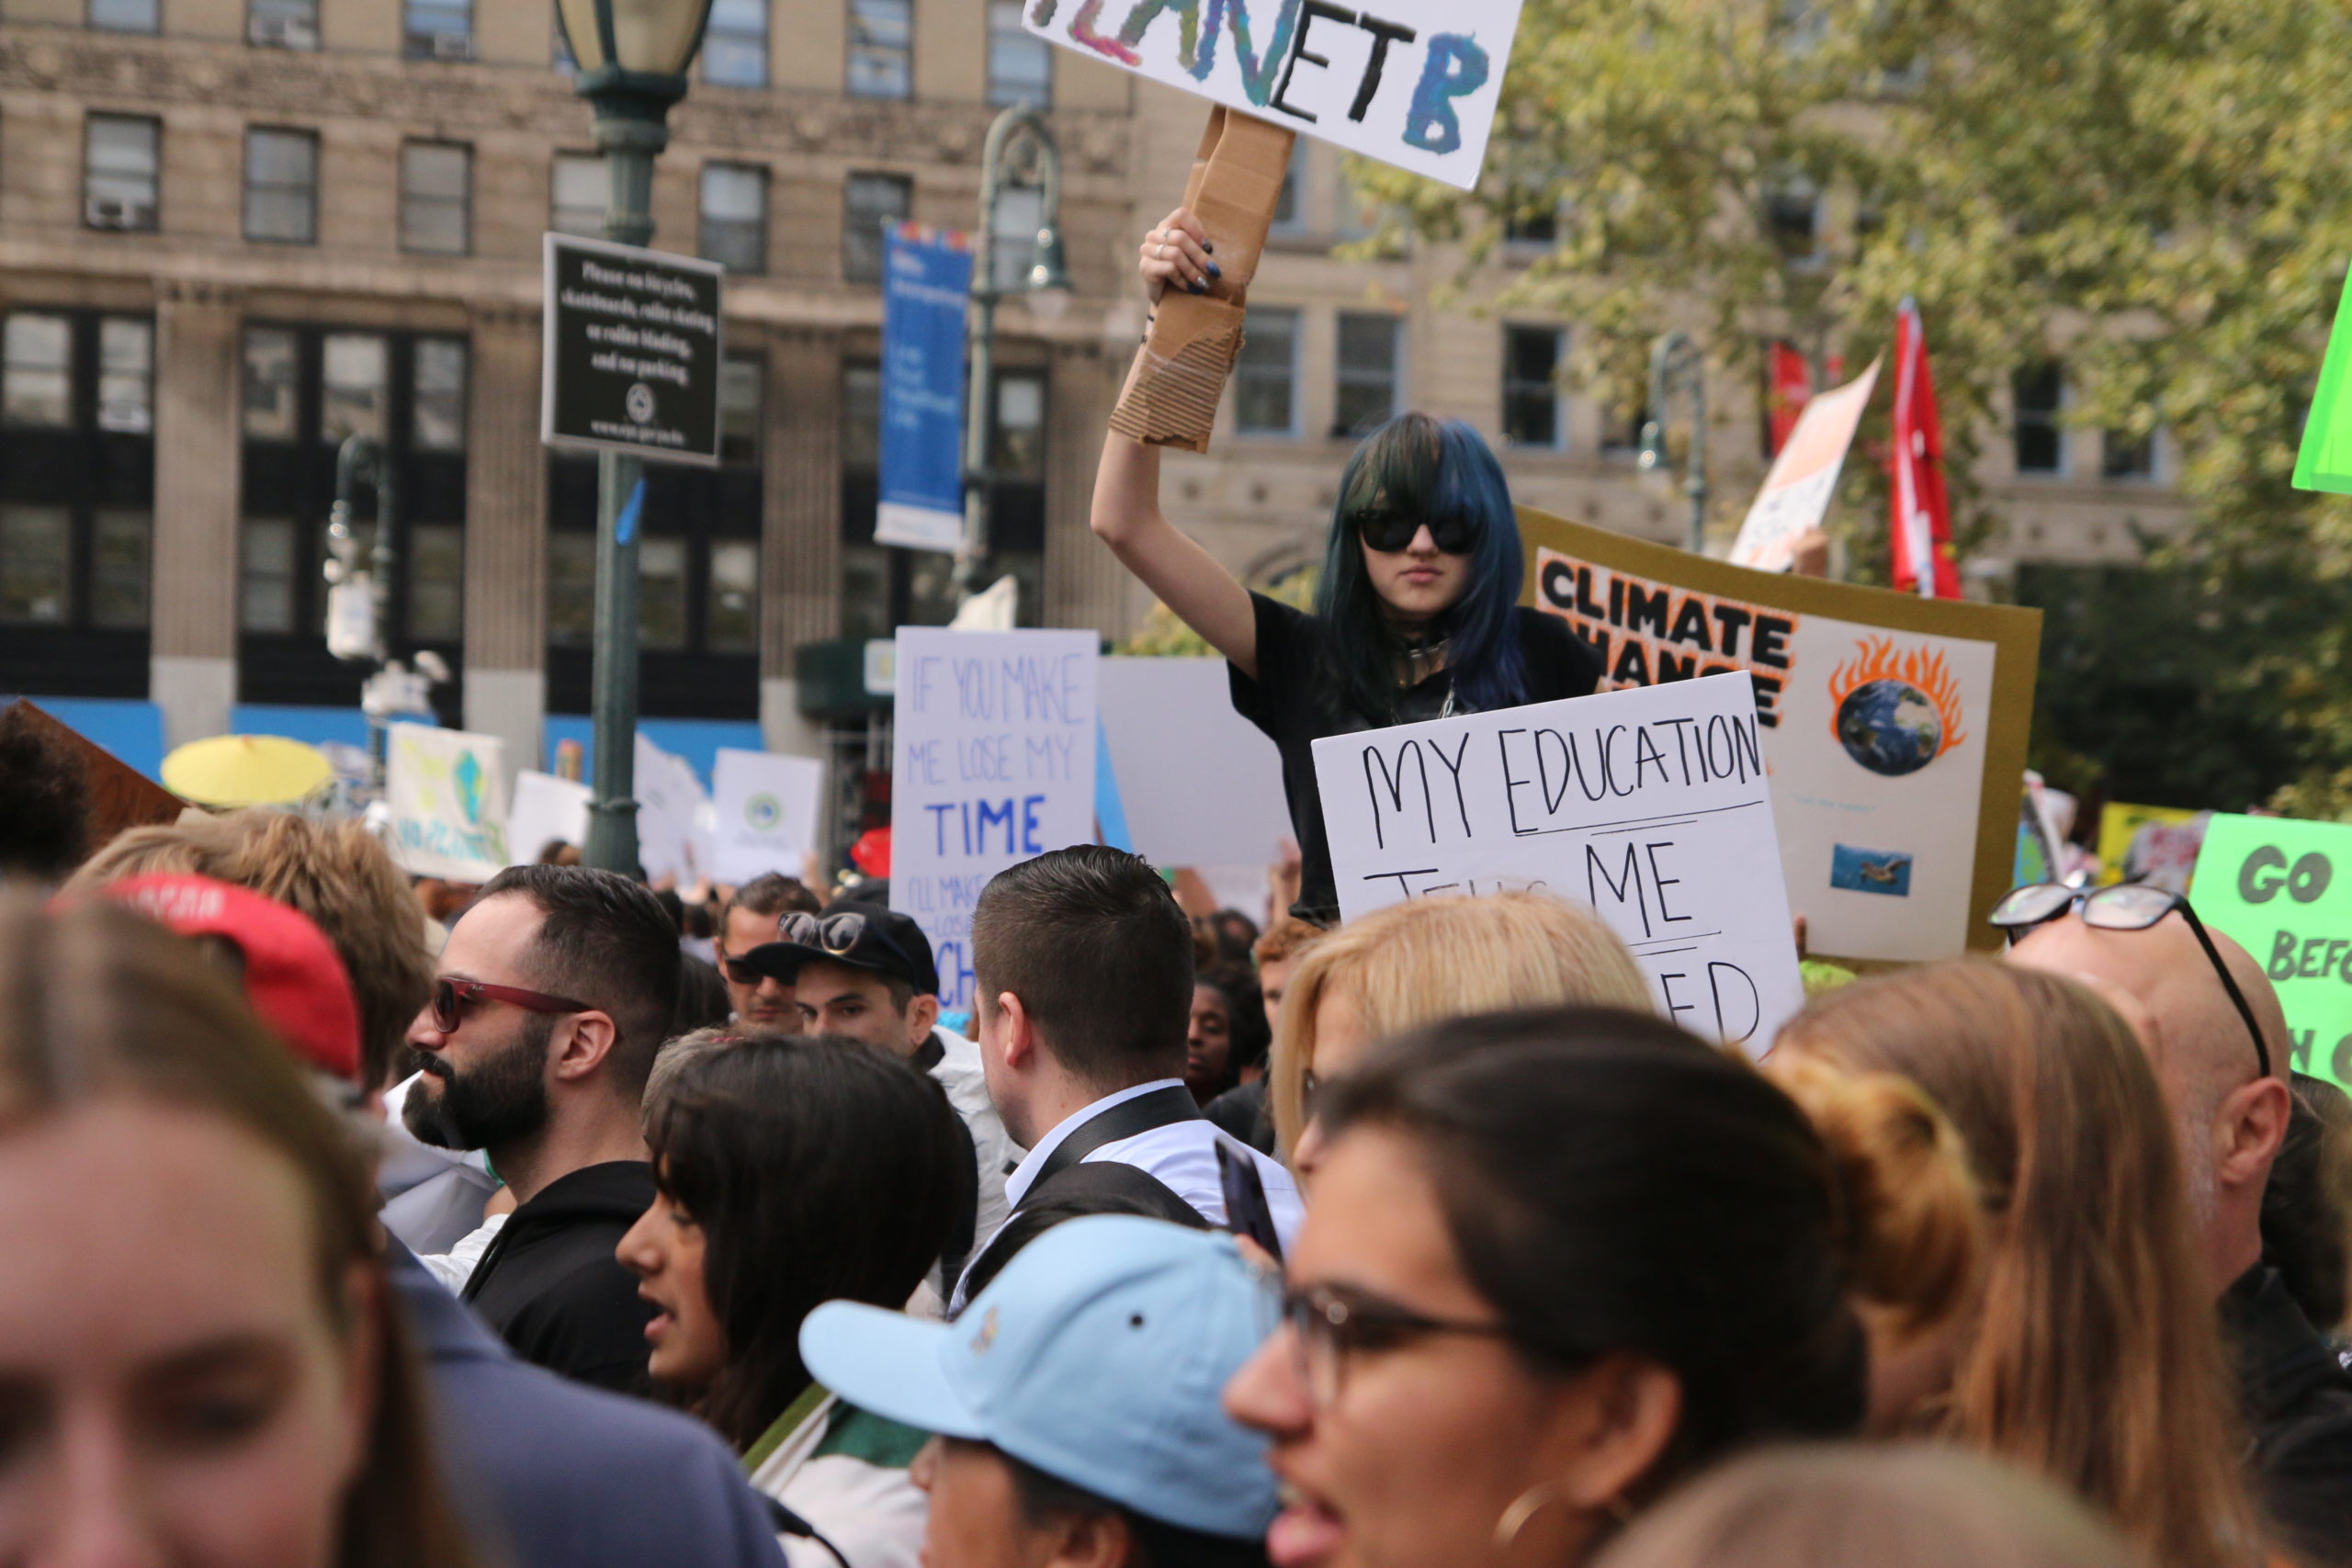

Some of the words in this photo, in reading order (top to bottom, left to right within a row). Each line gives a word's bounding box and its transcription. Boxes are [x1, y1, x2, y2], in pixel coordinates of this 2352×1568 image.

[1402, 31, 1489, 154] B
[1541, 559, 1793, 670] CLIMATE
[911, 656, 943, 712] IF
[951, 656, 995, 721] YOU
[1001, 653, 1086, 724] MAKE
[908, 739, 944, 784] ME
[956, 734, 1014, 782] LOSE
[1025, 733, 1074, 781] MY
[1363, 732, 1472, 850] MY
[1498, 713, 1762, 834] EDUCATION
[924, 794, 1046, 857] TIME
[1586, 841, 1693, 938] ME
[2237, 844, 2334, 905] GO
